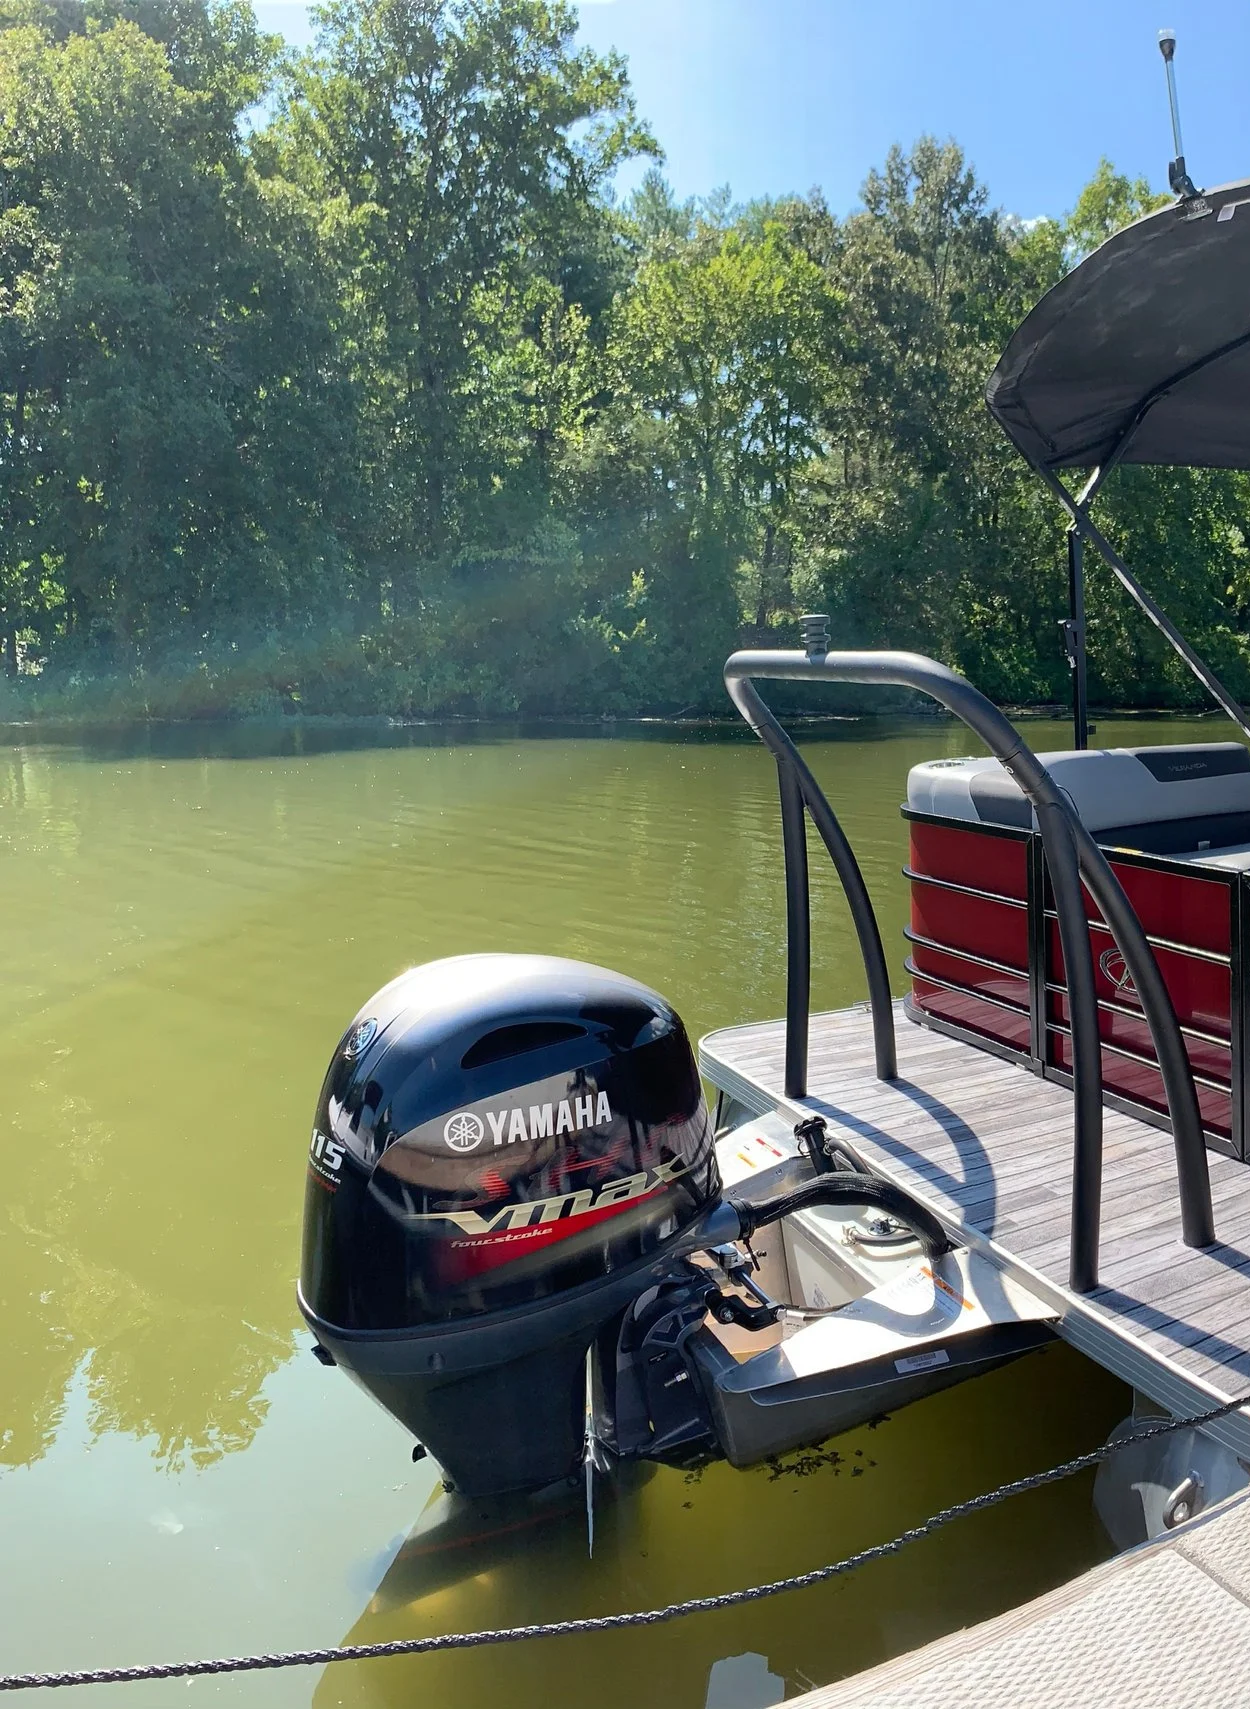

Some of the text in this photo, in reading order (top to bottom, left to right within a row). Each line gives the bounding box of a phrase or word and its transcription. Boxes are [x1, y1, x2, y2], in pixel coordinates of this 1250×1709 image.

[486, 1091, 613, 1146] YAMAHA
[309, 1153, 342, 1185] stroke
[451, 1227, 553, 1249] fourstroke
